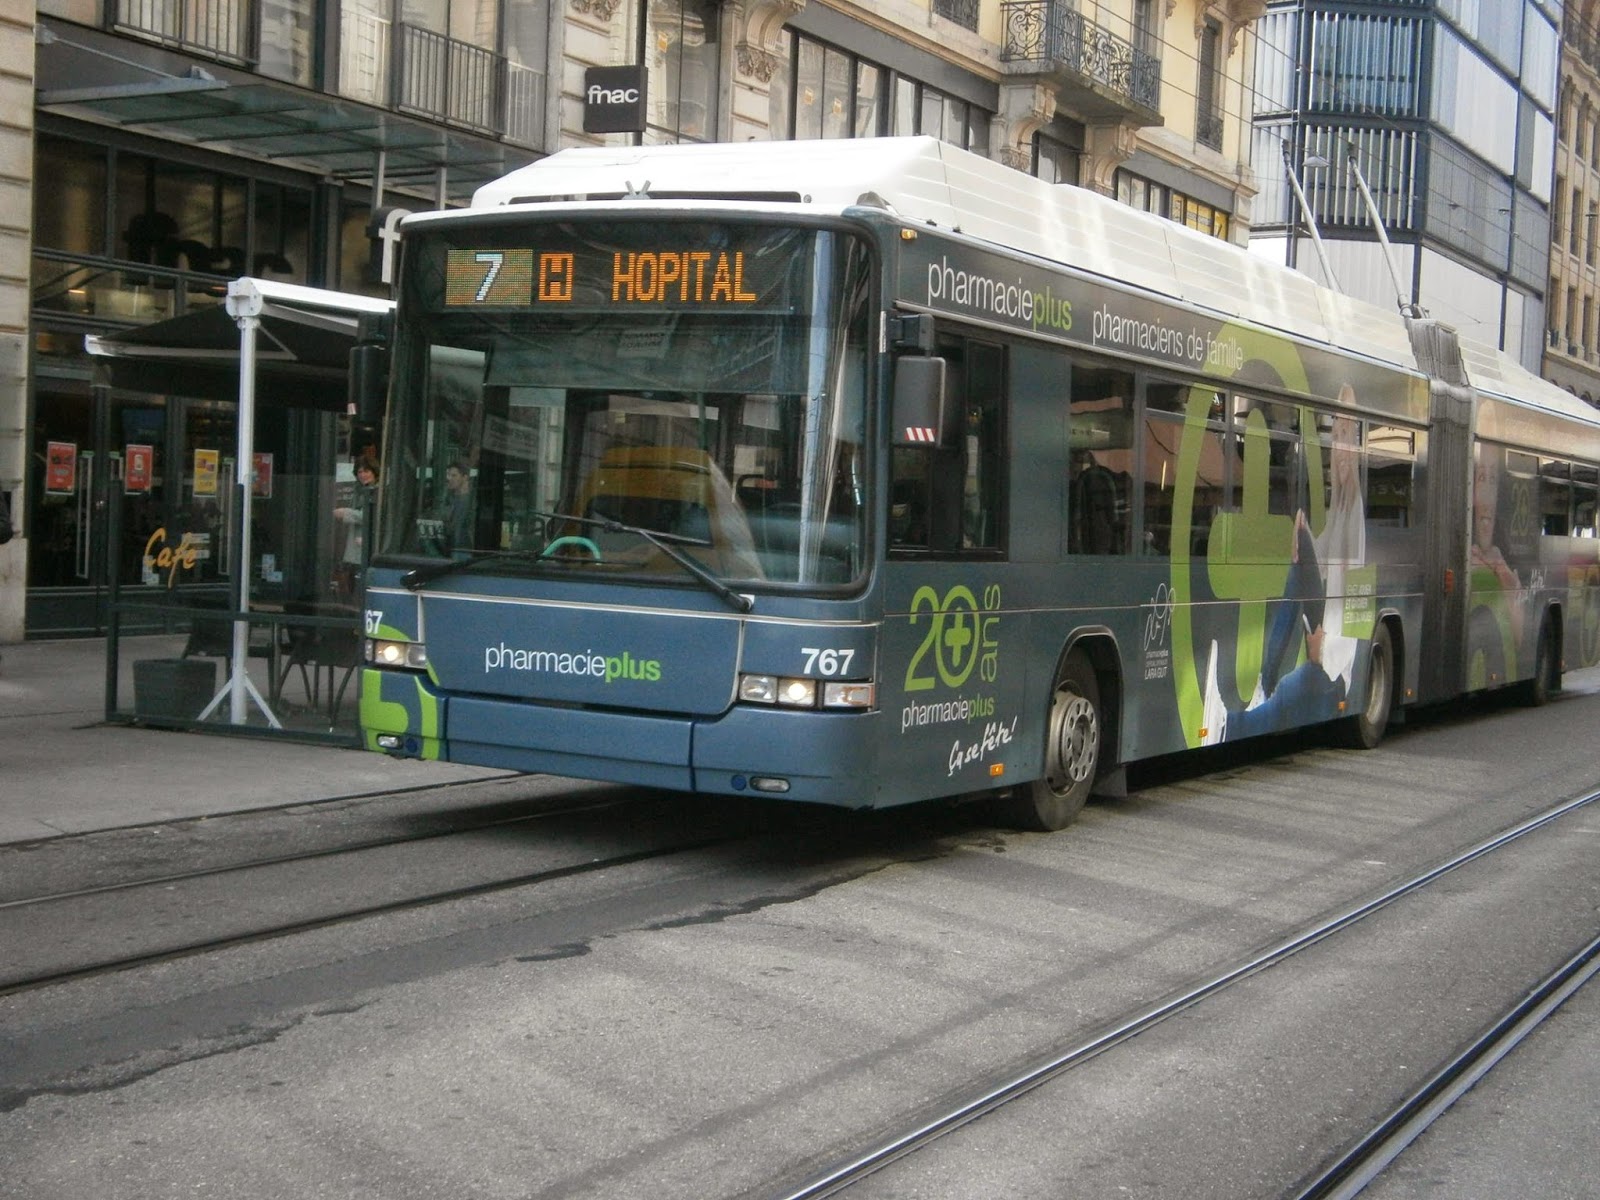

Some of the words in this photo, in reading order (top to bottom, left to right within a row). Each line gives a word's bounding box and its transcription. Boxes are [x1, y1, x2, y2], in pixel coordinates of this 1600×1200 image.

[587, 84, 639, 105] fnac
[474, 252, 503, 302] 7
[611, 251, 757, 301] HOPITAL
[927, 255, 1073, 332] pharmacieplus
[1092, 303, 1183, 357] pharmaciens
[1186, 328, 1203, 361] de
[1205, 331, 1244, 371] famille
[904, 584, 981, 692] 20
[980, 584, 1001, 683] ans
[485, 642, 661, 683] pharmacieplus
[801, 648, 855, 676] 767
[901, 694, 994, 734] pharmacieplus
